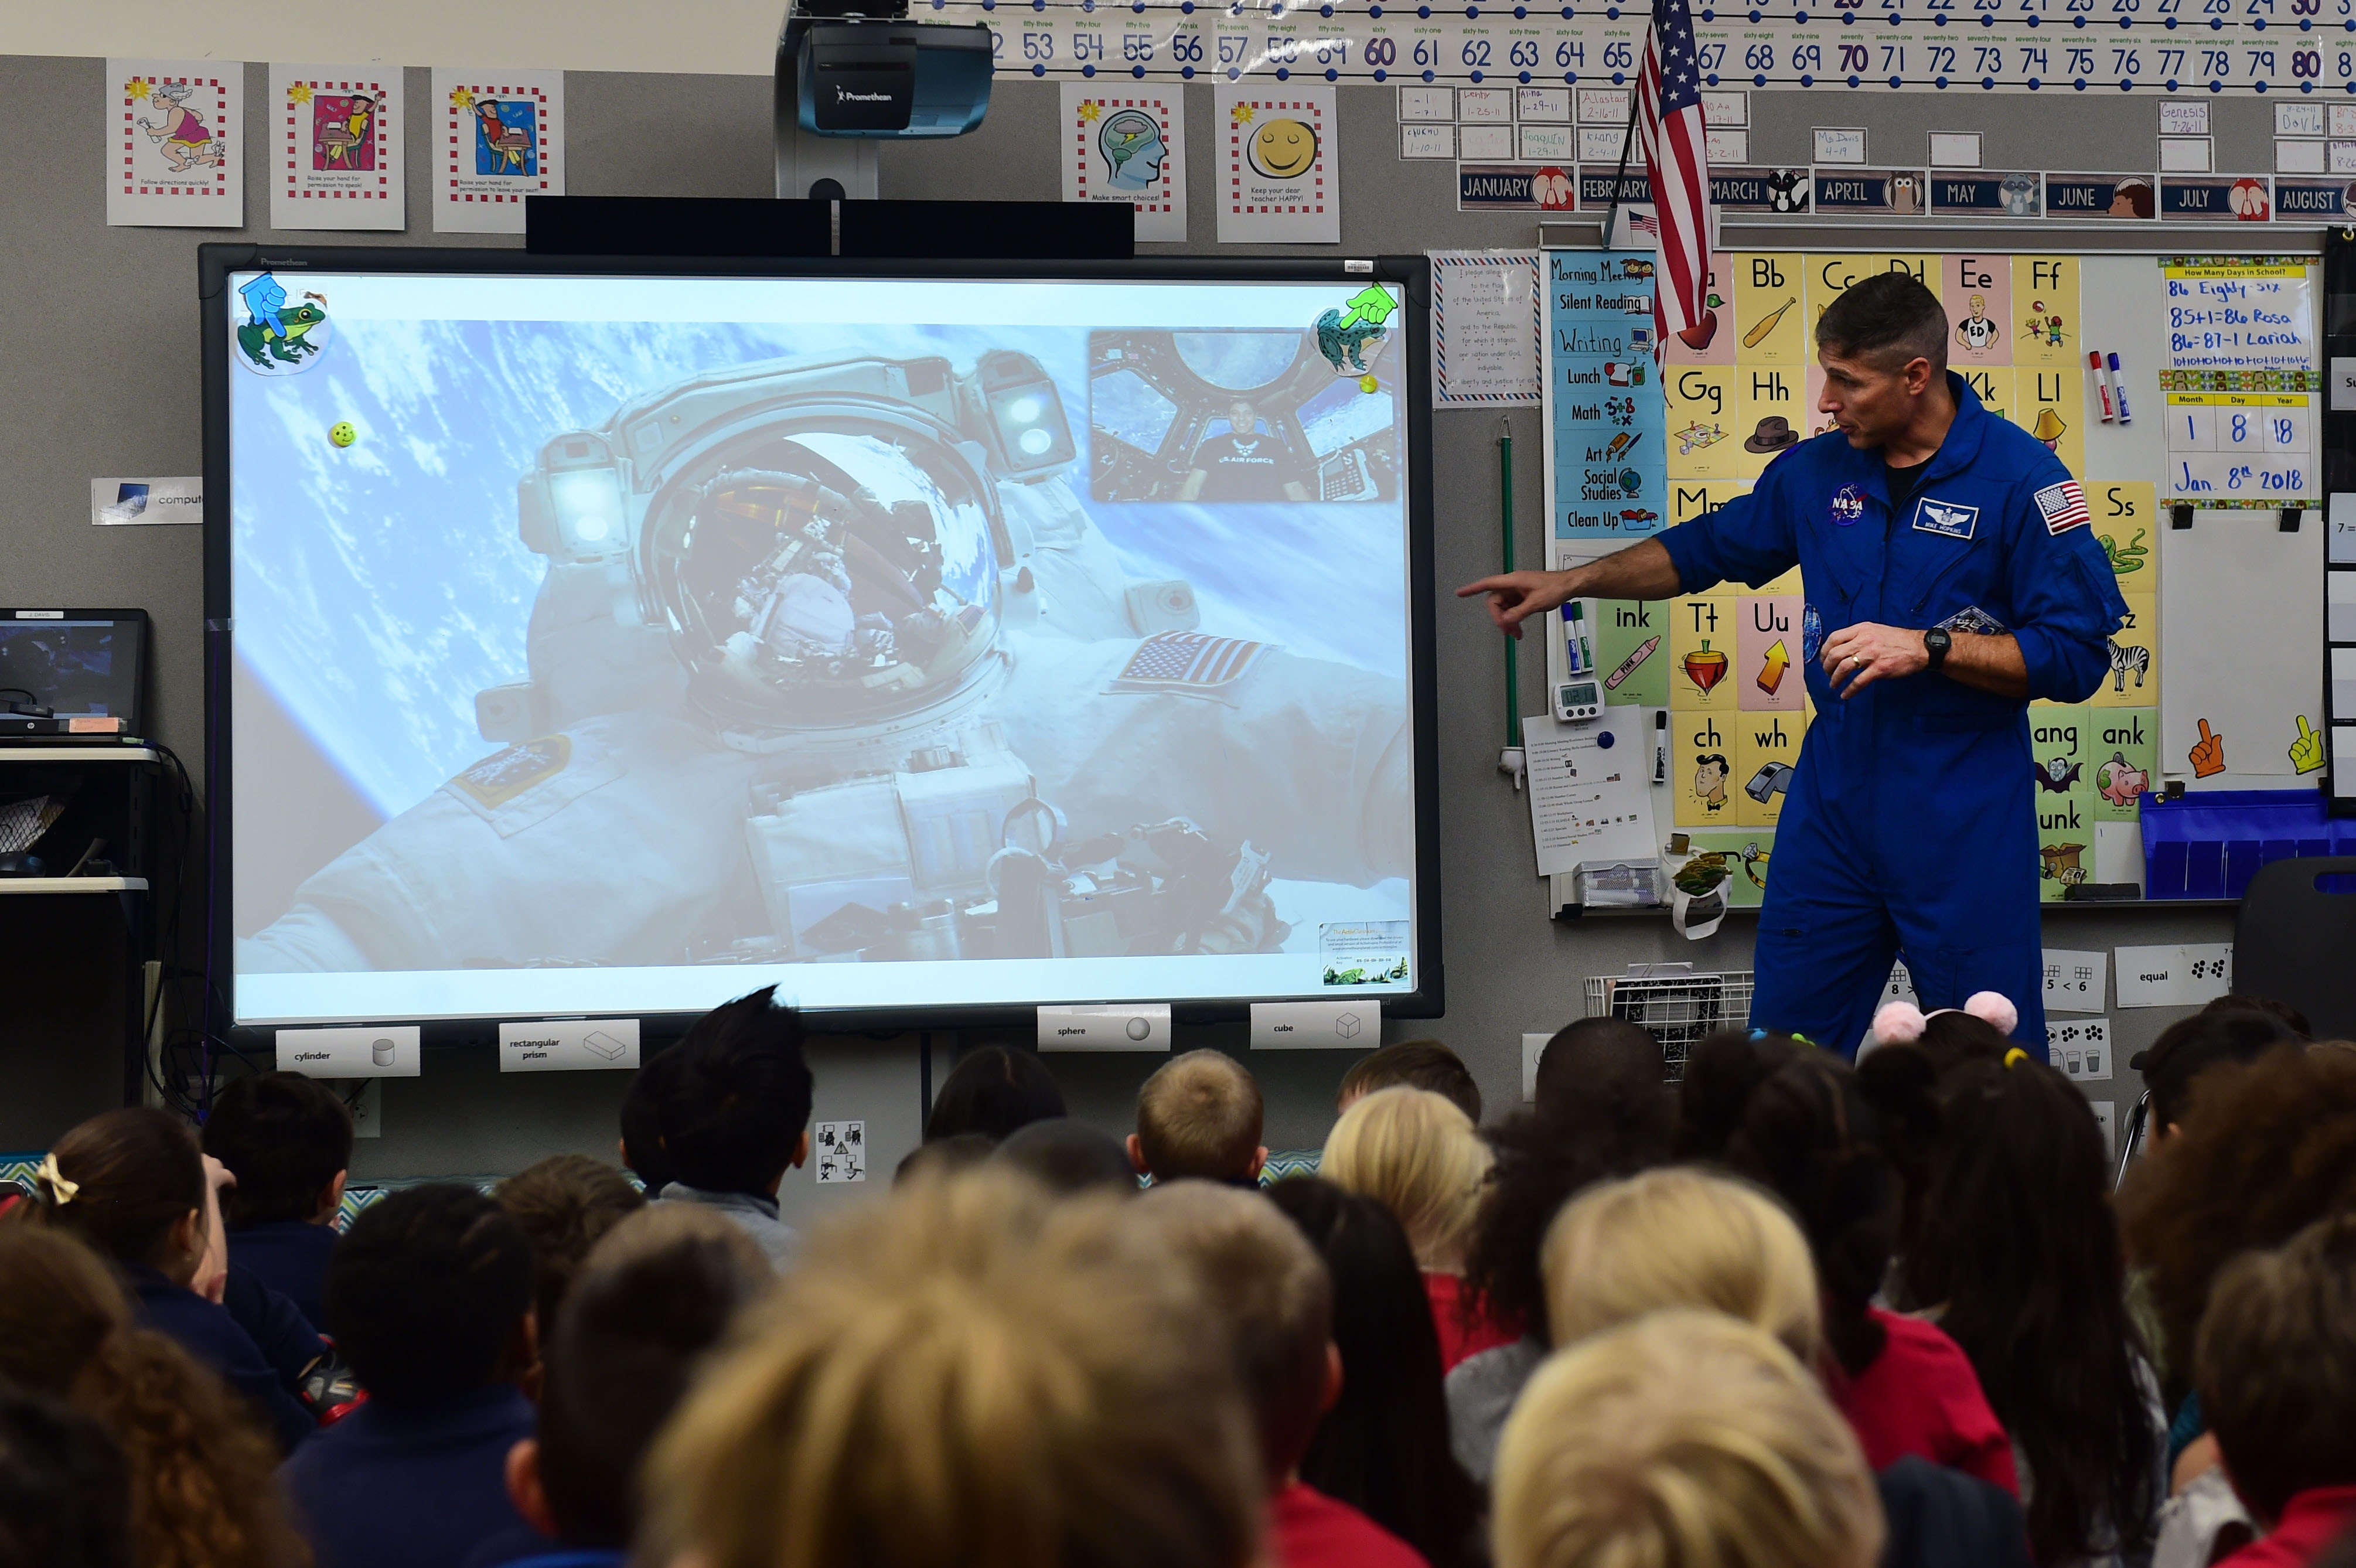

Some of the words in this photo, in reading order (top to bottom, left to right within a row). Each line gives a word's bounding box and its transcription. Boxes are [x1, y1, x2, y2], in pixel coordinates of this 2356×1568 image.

[1023, 33, 1055, 60] 53
[1073, 33, 1104, 61] 54
[1123, 35, 1154, 62] 55
[1173, 35, 1203, 62] 56
[1218, 36, 1248, 63] 57
[1267, 36, 1298, 64] 58
[1840, 33, 1864, 42] seventy
[1365, 38, 1396, 66] 60
[1413, 39, 1438, 66] 61
[1462, 40, 1491, 67] 62
[1510, 40, 1539, 67] 63
[1556, 42, 1585, 67] 64
[1604, 42, 1632, 69] 65
[1699, 44, 1727, 70] 67
[1745, 45, 1774, 70] 68
[1792, 45, 1820, 71] 69
[1838, 45, 1869, 73] 70
[1881, 46, 1904, 72] 71
[1927, 47, 1956, 73] 72
[1973, 47, 2002, 73] 73
[2020, 48, 2047, 74] 74
[2066, 49, 2094, 74] 75
[2112, 49, 2140, 74] 76
[2158, 50, 2185, 75] 77
[2201, 50, 2229, 76] 78
[2247, 51, 2275, 77] 79
[2292, 51, 2321, 77] 80
[846, 91, 892, 101] Promethean
[1587, 107, 1618, 118] 2-16-11
[2161, 103, 2206, 118] Genesis
[1836, 132, 1859, 142] Davis
[2171, 121, 2201, 133] 7-26-11
[1529, 148, 1559, 156] 1-29-11
[1588, 147, 1617, 156] 2-4-11
[1826, 146, 1847, 156] 4-19
[1134, 194, 1160, 202] choices!
[1251, 187, 1267, 196] Keep
[1464, 178, 1529, 197] JANUARY
[1710, 181, 1758, 200] MARCH
[1825, 182, 1868, 201] APRIL
[1948, 185, 1976, 203] MAY
[2058, 188, 2095, 206] JUNE
[2179, 189, 2210, 207] JULY
[2283, 191, 2335, 210] AUGUST
[260, 257, 308, 267] Promethean
[1551, 258, 1597, 285] Morning
[1752, 258, 1785, 287] Bb
[1961, 259, 1992, 288] Ee
[2227, 269, 2245, 277] Days
[1822, 261, 1856, 289] Cc
[2033, 261, 2062, 290] Ff
[2169, 280, 2189, 297] 86
[1560, 293, 1591, 309] Silent
[1595, 293, 1641, 312] Reading
[2253, 309, 2292, 324] Rosa
[1559, 326, 1622, 357] Writing
[1970, 325, 1985, 337] ED
[2246, 332, 2302, 346] Lariah
[1568, 367, 1600, 384] Lunch
[1752, 371, 1789, 401] Hh
[1966, 371, 1996, 401] Kk
[1679, 371, 1721, 415] Gg
[1572, 403, 1601, 420] Math
[2188, 415, 2194, 439] 1
[2232, 414, 2246, 442] 8
[2273, 418, 2293, 444] 18
[1586, 446, 1602, 462] Art
[1584, 467, 1617, 485] Social
[2259, 469, 2303, 490] 2018
[159, 495, 203, 506] comput
[1581, 485, 1622, 500] Studies
[1832, 498, 1863, 510] NASA
[2107, 488, 2135, 516] Ss
[1568, 511, 1598, 527] Clean
[1603, 512, 1618, 530] Up
[1617, 600, 1650, 627] ink
[1687, 603, 1718, 632] Tt
[1754, 602, 1788, 632] Uu
[1620, 658, 1635, 674] PINK
[1694, 717, 1721, 747] ch
[1755, 718, 1787, 747] wh
[2034, 726, 2078, 756] ang
[2103, 715, 2144, 745] ank
[2040, 800, 2081, 829] unk
[1891, 984, 1899, 994] 8
[2047, 979, 2054, 990] 5
[2079, 981, 2086, 991] 6
[2140, 970, 2168, 983] equal
[1058, 1026, 1086, 1037] sphere
[1274, 1023, 1294, 1032] cube
[294, 1051, 330, 1062] cylinder
[510, 1039, 560, 1050] rectangular
[522, 1049, 547, 1061] prism
